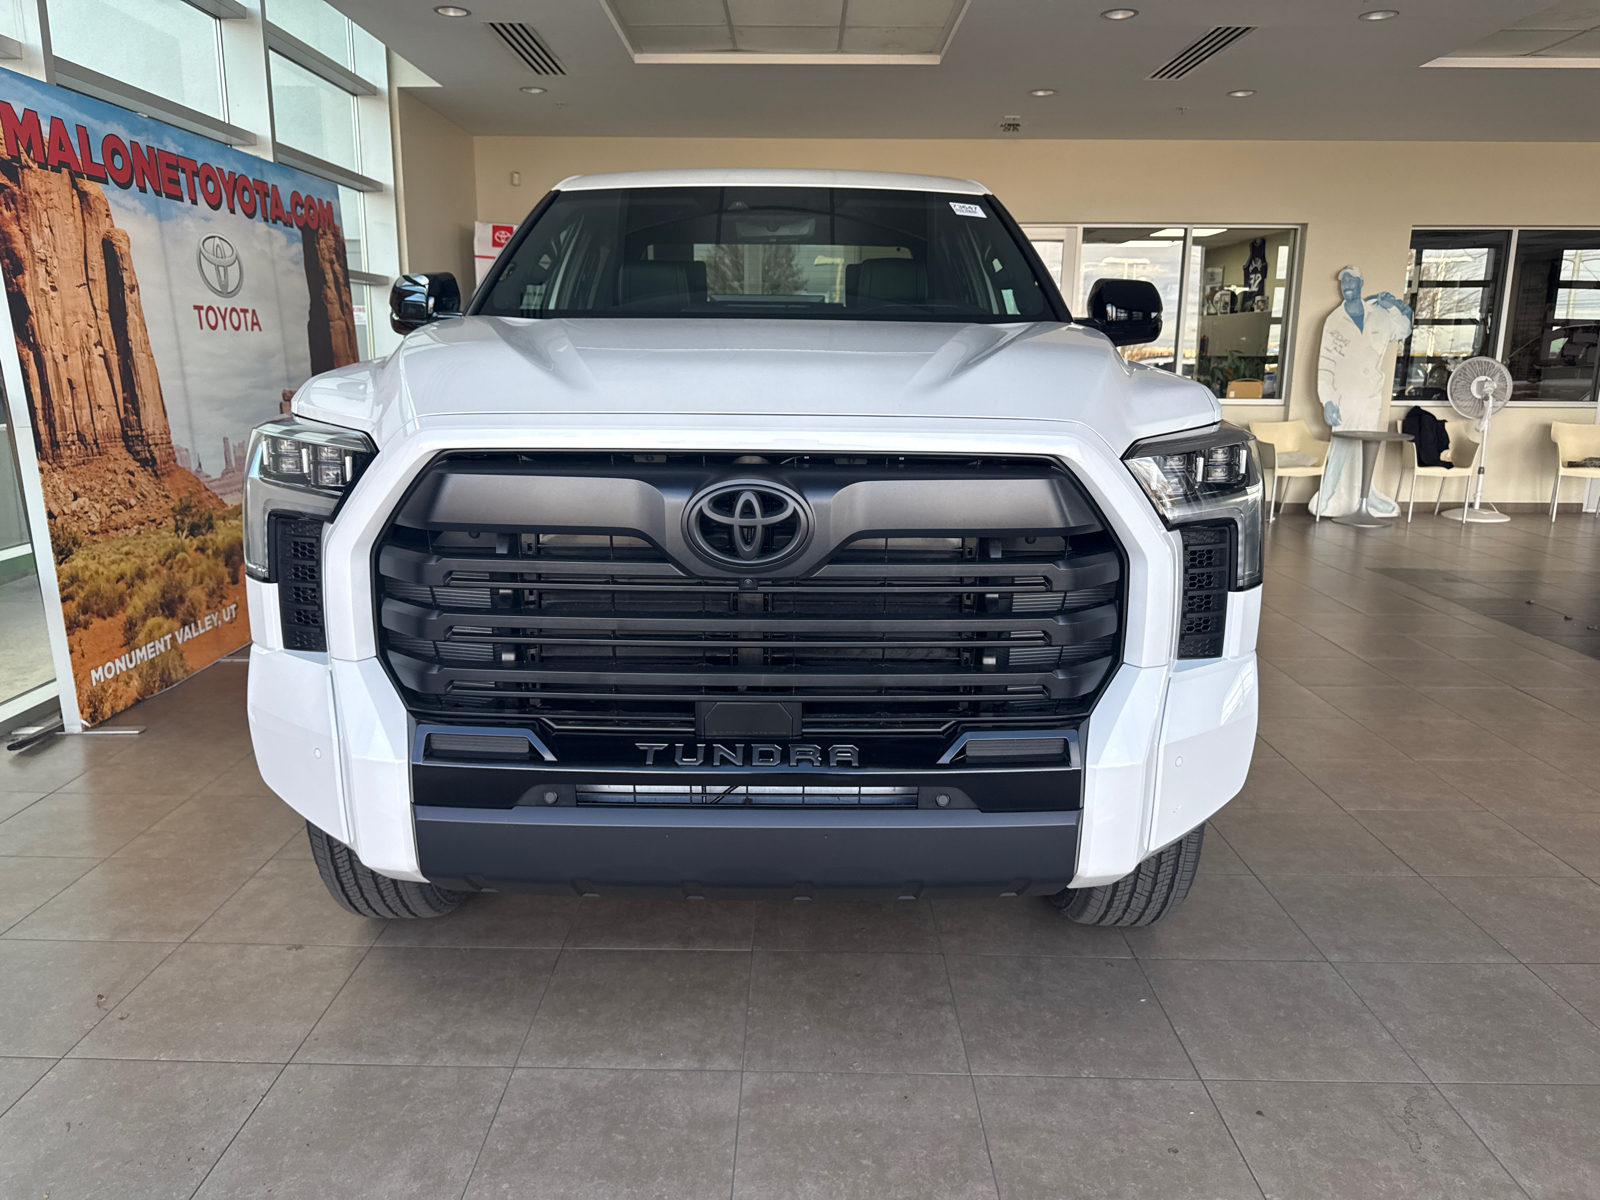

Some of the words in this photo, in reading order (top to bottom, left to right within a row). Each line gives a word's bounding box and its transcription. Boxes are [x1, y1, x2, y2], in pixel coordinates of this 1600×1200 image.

[0, 100, 337, 233] MALONETOYOTA.COM
[193, 304, 262, 332] TOYOTA
[90, 633, 173, 687] MONUMENT
[174, 611, 222, 645] VALLEY,
[222, 603, 238, 622] UT
[635, 742, 860, 768] TUNDRA
